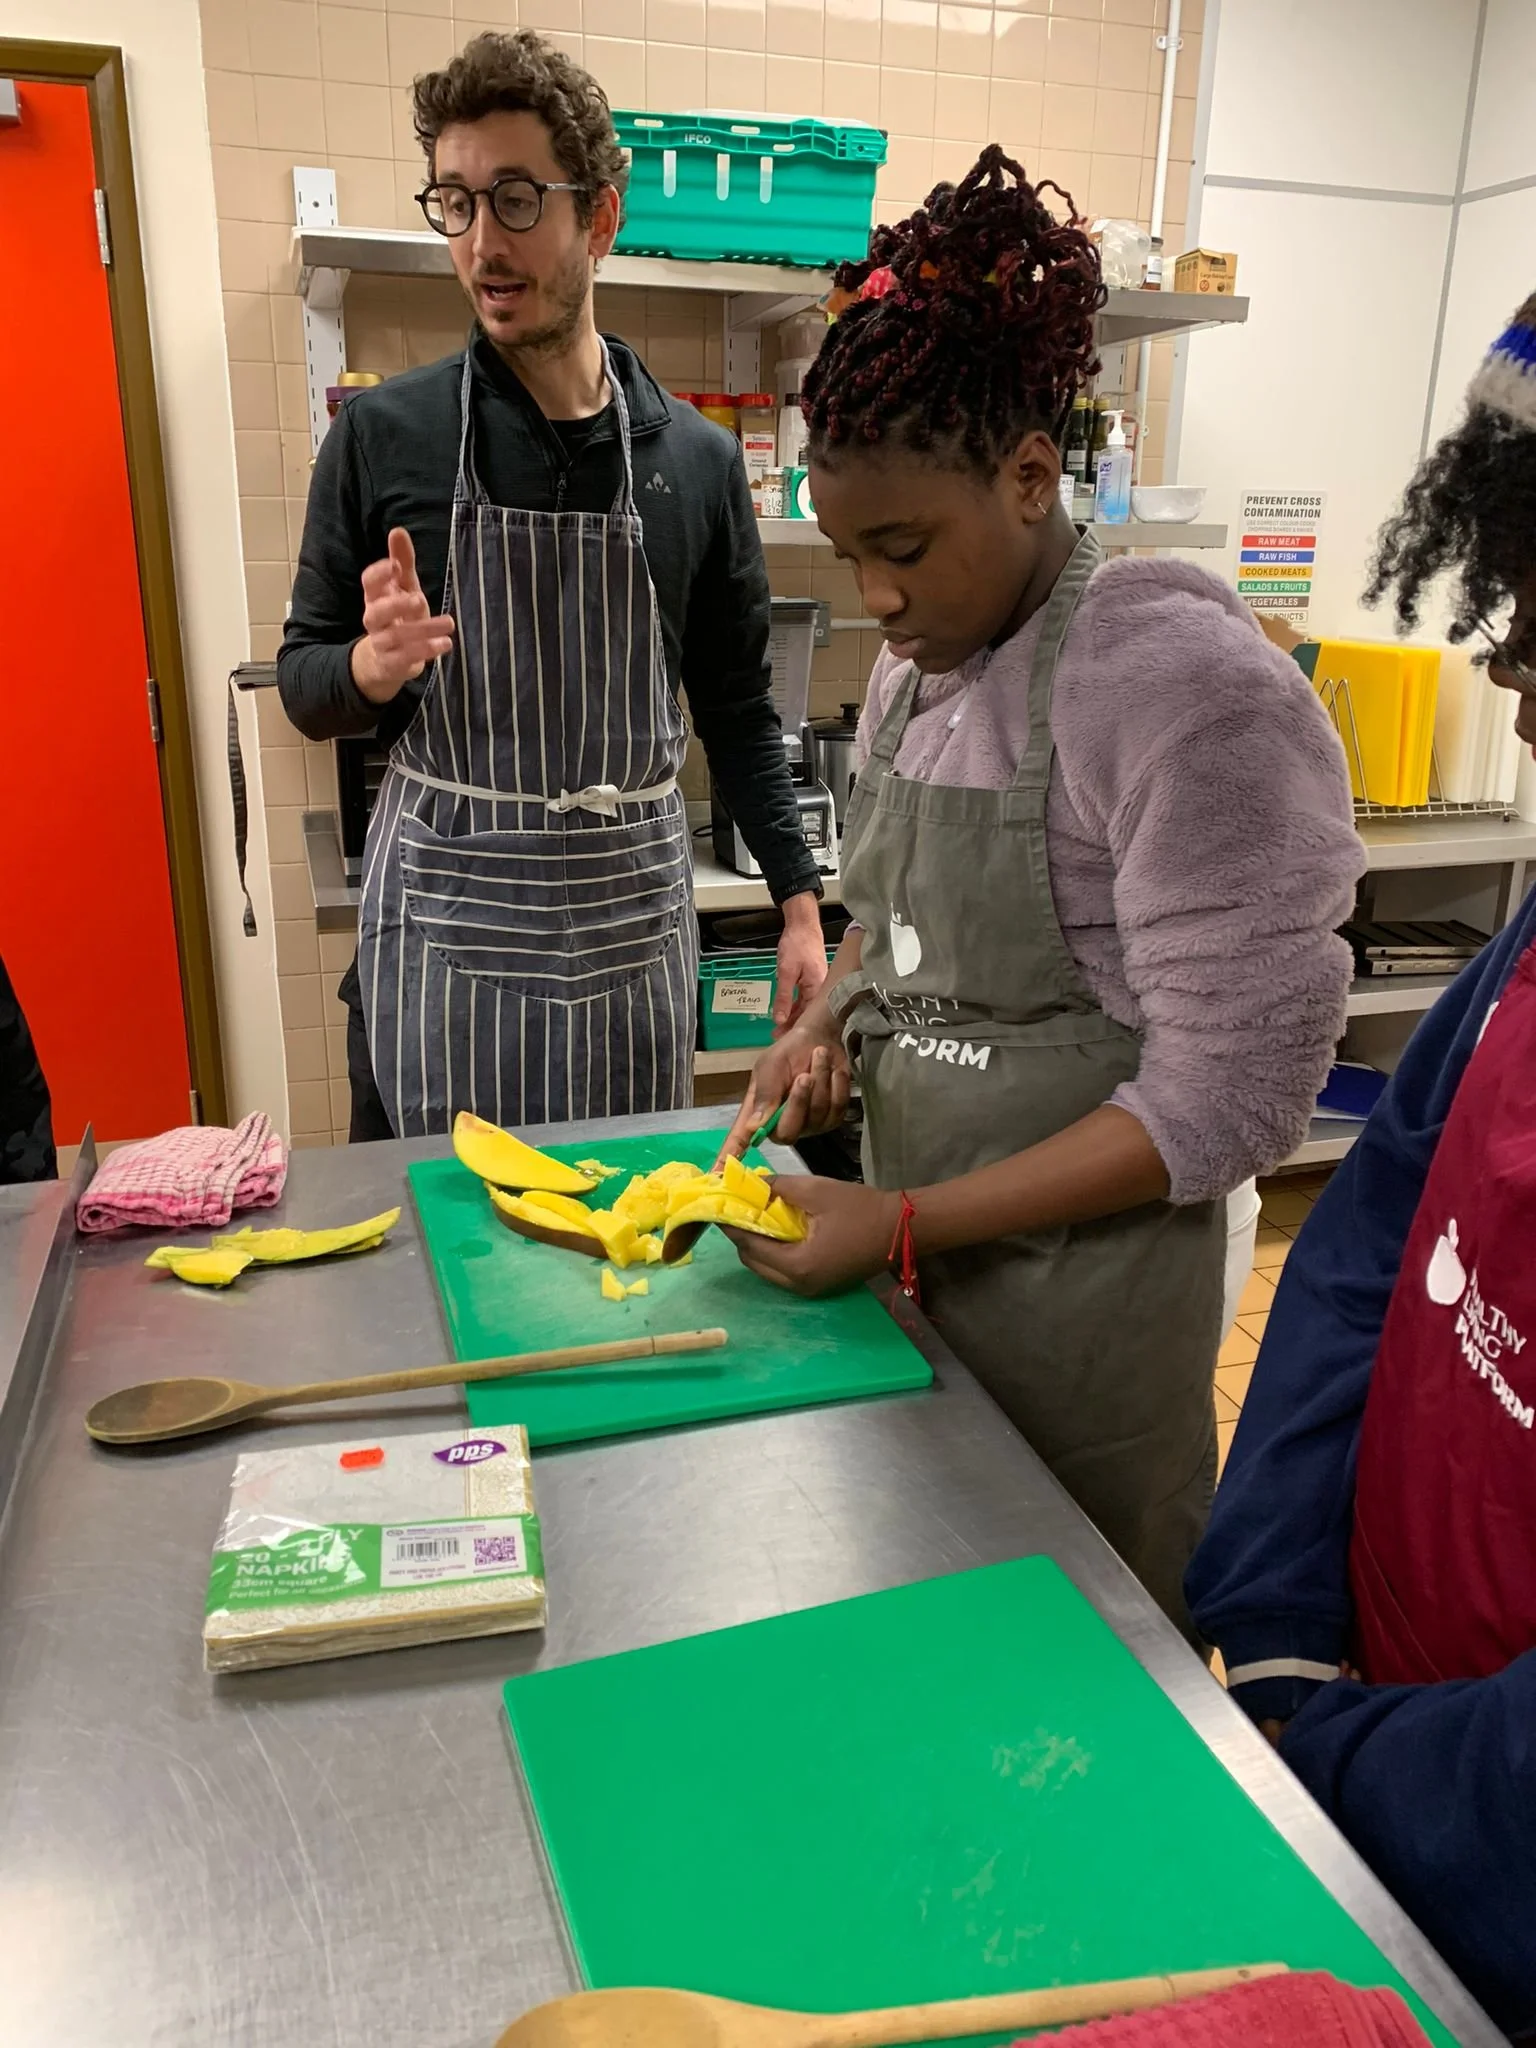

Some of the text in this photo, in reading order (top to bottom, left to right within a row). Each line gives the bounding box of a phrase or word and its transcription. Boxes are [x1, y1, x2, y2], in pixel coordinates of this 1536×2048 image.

[684, 133, 712, 145] IFCO
[1246, 496, 1322, 506] PREVENT CROSS
[1244, 507, 1321, 518] CONTAMINATION
[1278, 538, 1301, 546] MEAT
[1259, 552, 1297, 561] RAW FISH
[1245, 567, 1307, 576] COOKED MEATS
[1241, 582, 1272, 591] SALADS
[1280, 583, 1307, 591] FRUITS
[1248, 597, 1298, 606] VEGETABLES
[894, 1033, 991, 1070] FORM
[448, 1443, 494, 1462] pps
[236, 1552, 352, 1576] NAPKIN
